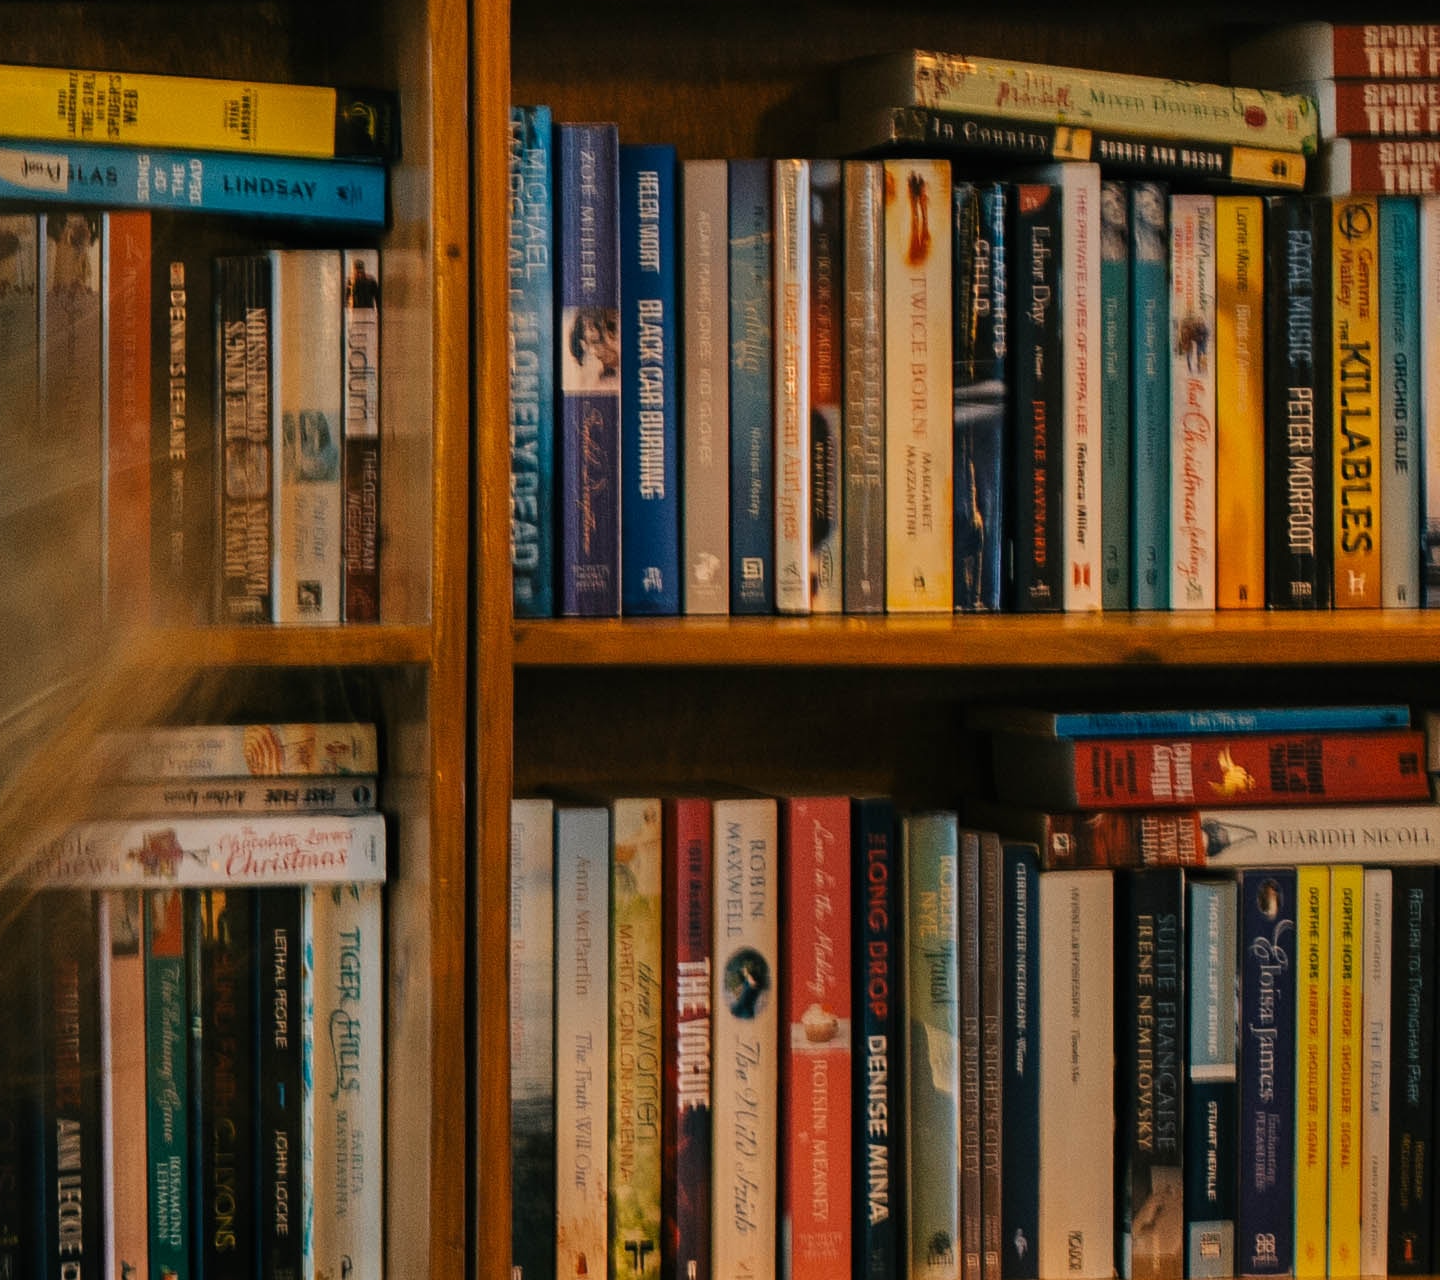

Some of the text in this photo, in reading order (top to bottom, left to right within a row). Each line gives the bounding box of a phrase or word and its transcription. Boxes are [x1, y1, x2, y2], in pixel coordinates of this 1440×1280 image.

[1341, 345, 1372, 554] KILLABLES
[868, 1035, 889, 1225] DENISE MINA
